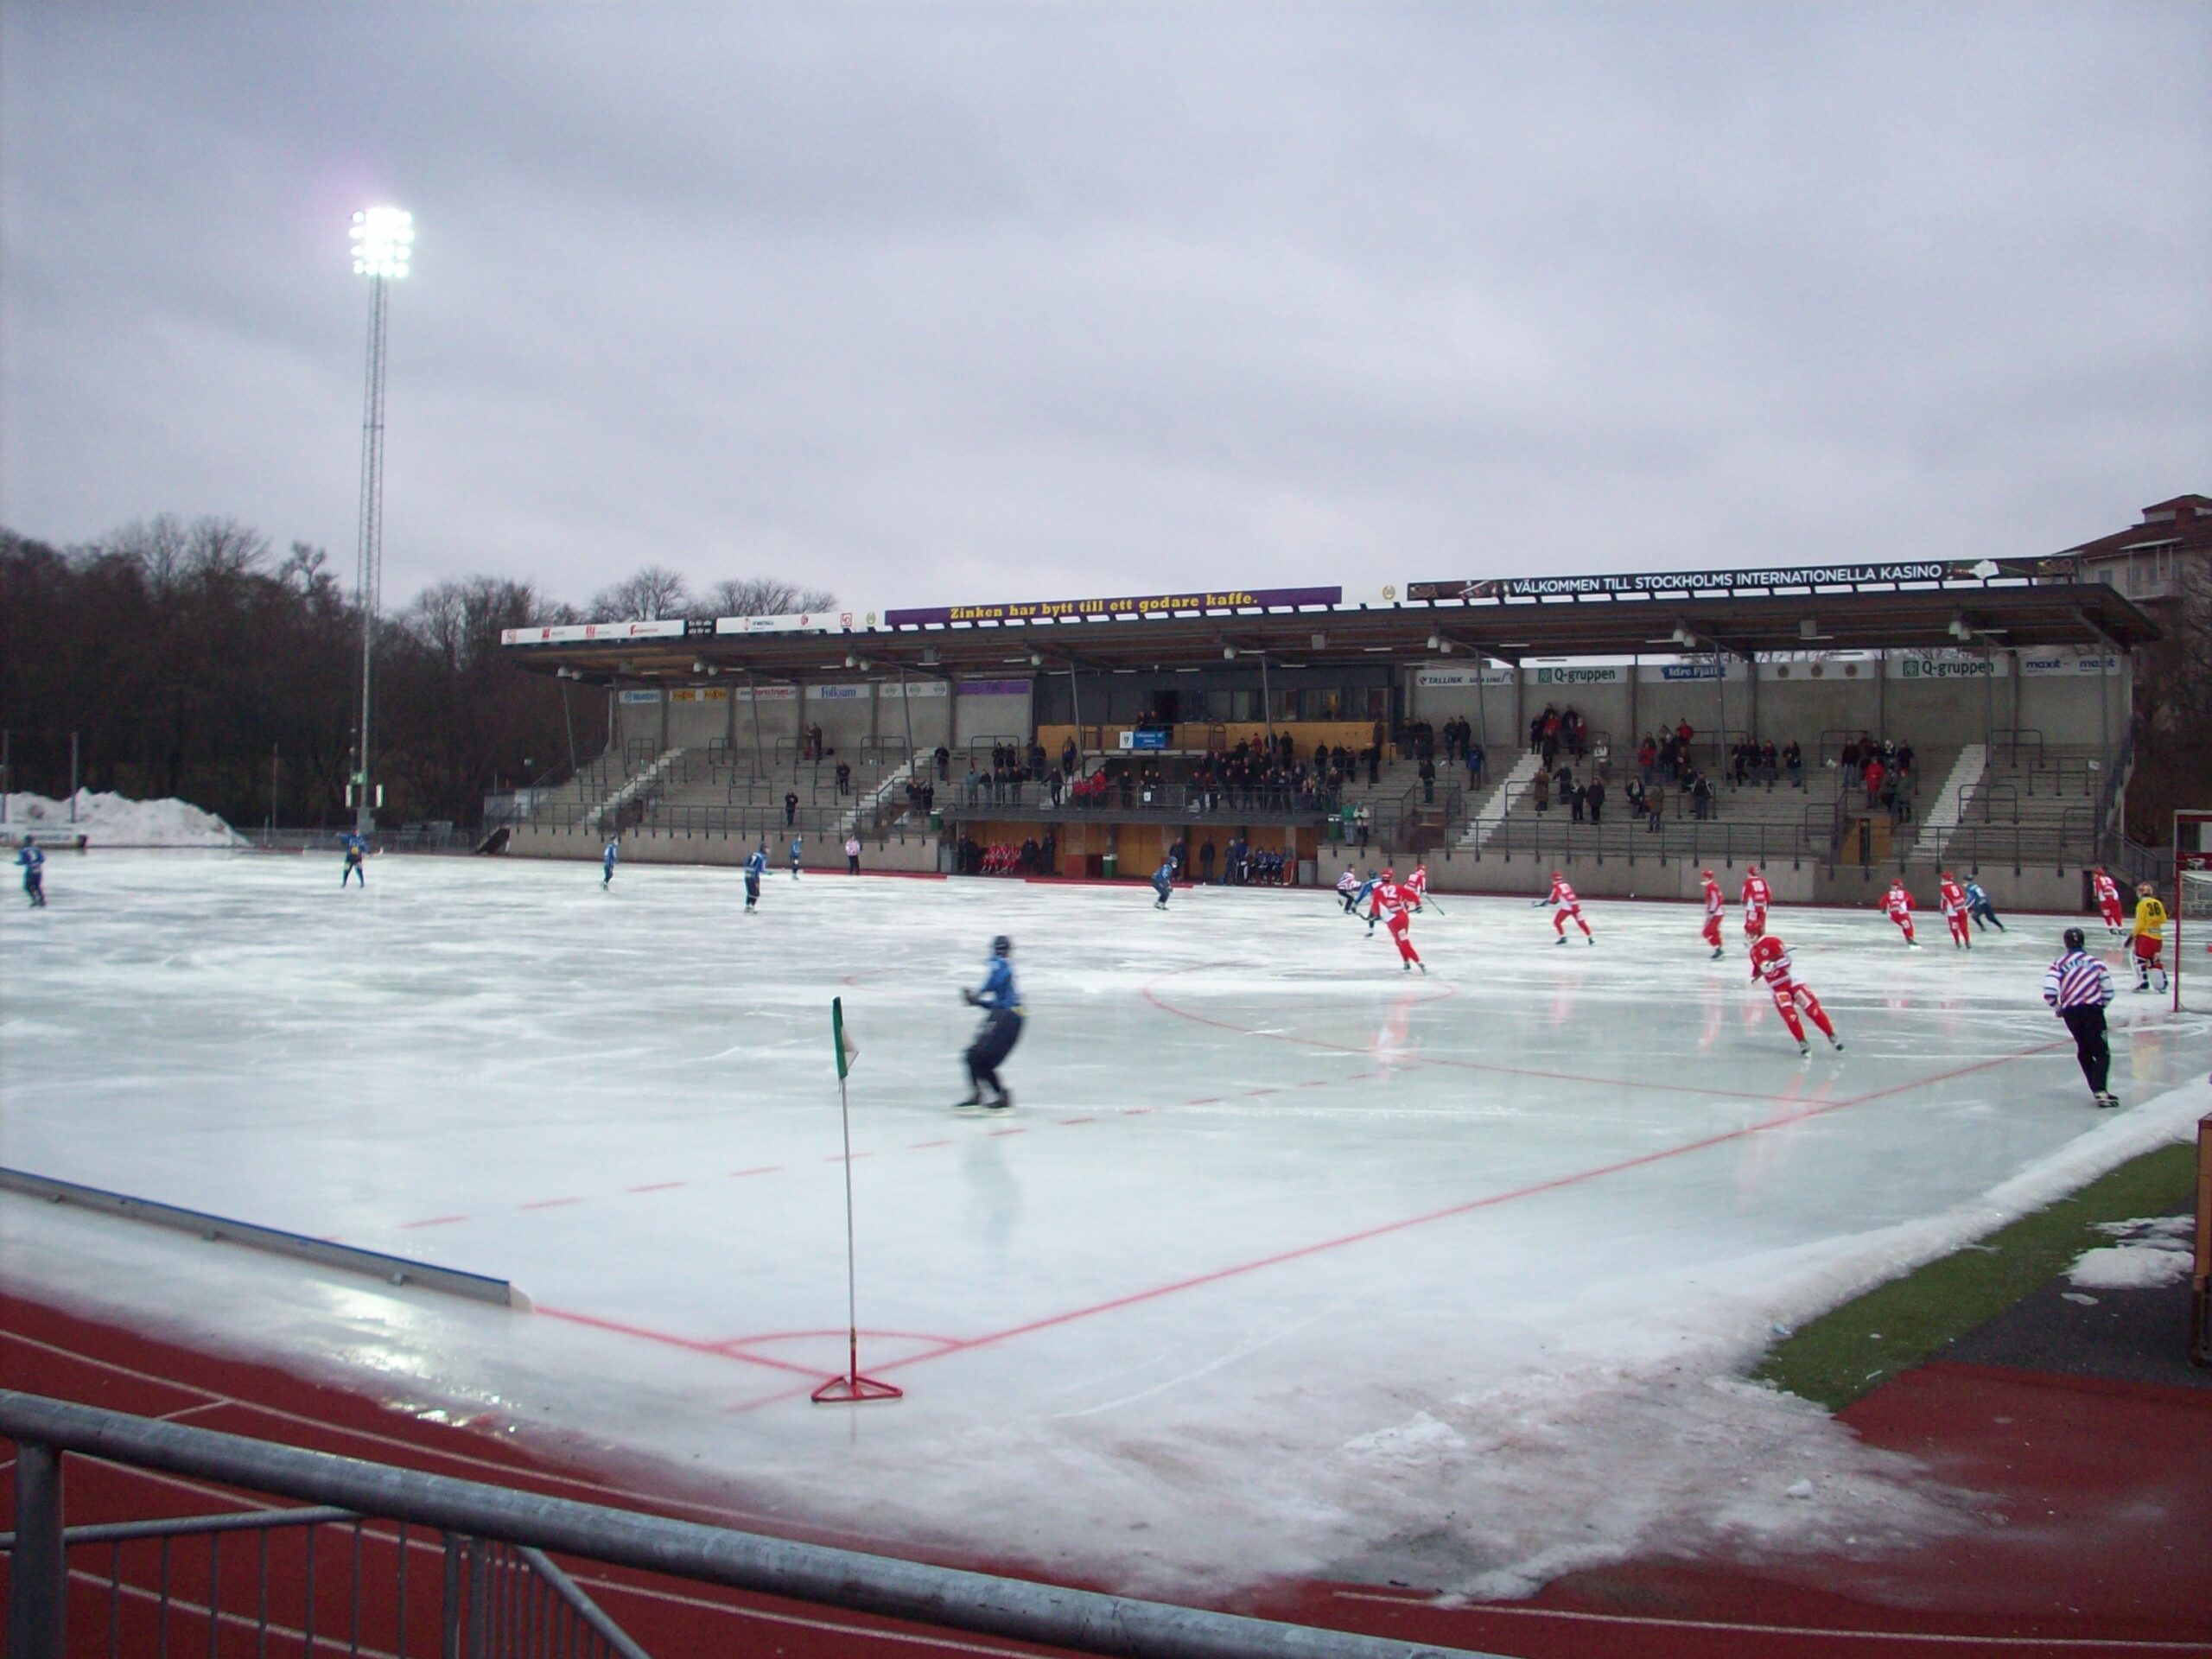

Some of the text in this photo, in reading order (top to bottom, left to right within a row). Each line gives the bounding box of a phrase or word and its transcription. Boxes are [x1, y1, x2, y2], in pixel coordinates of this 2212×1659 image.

[1513, 564, 1942, 594] VÄLKOMMEN TILL STOCKHOLMS INTERNATIONELLA KASINO
[950, 593, 1258, 620] Zinken har bytt till ett godare kaffe.
[2079, 658, 2115, 669] mait
[1554, 668, 1616, 683] Q-gruppen
[1380, 884, 1397, 898] 12
[2146, 902, 2161, 916] 36
